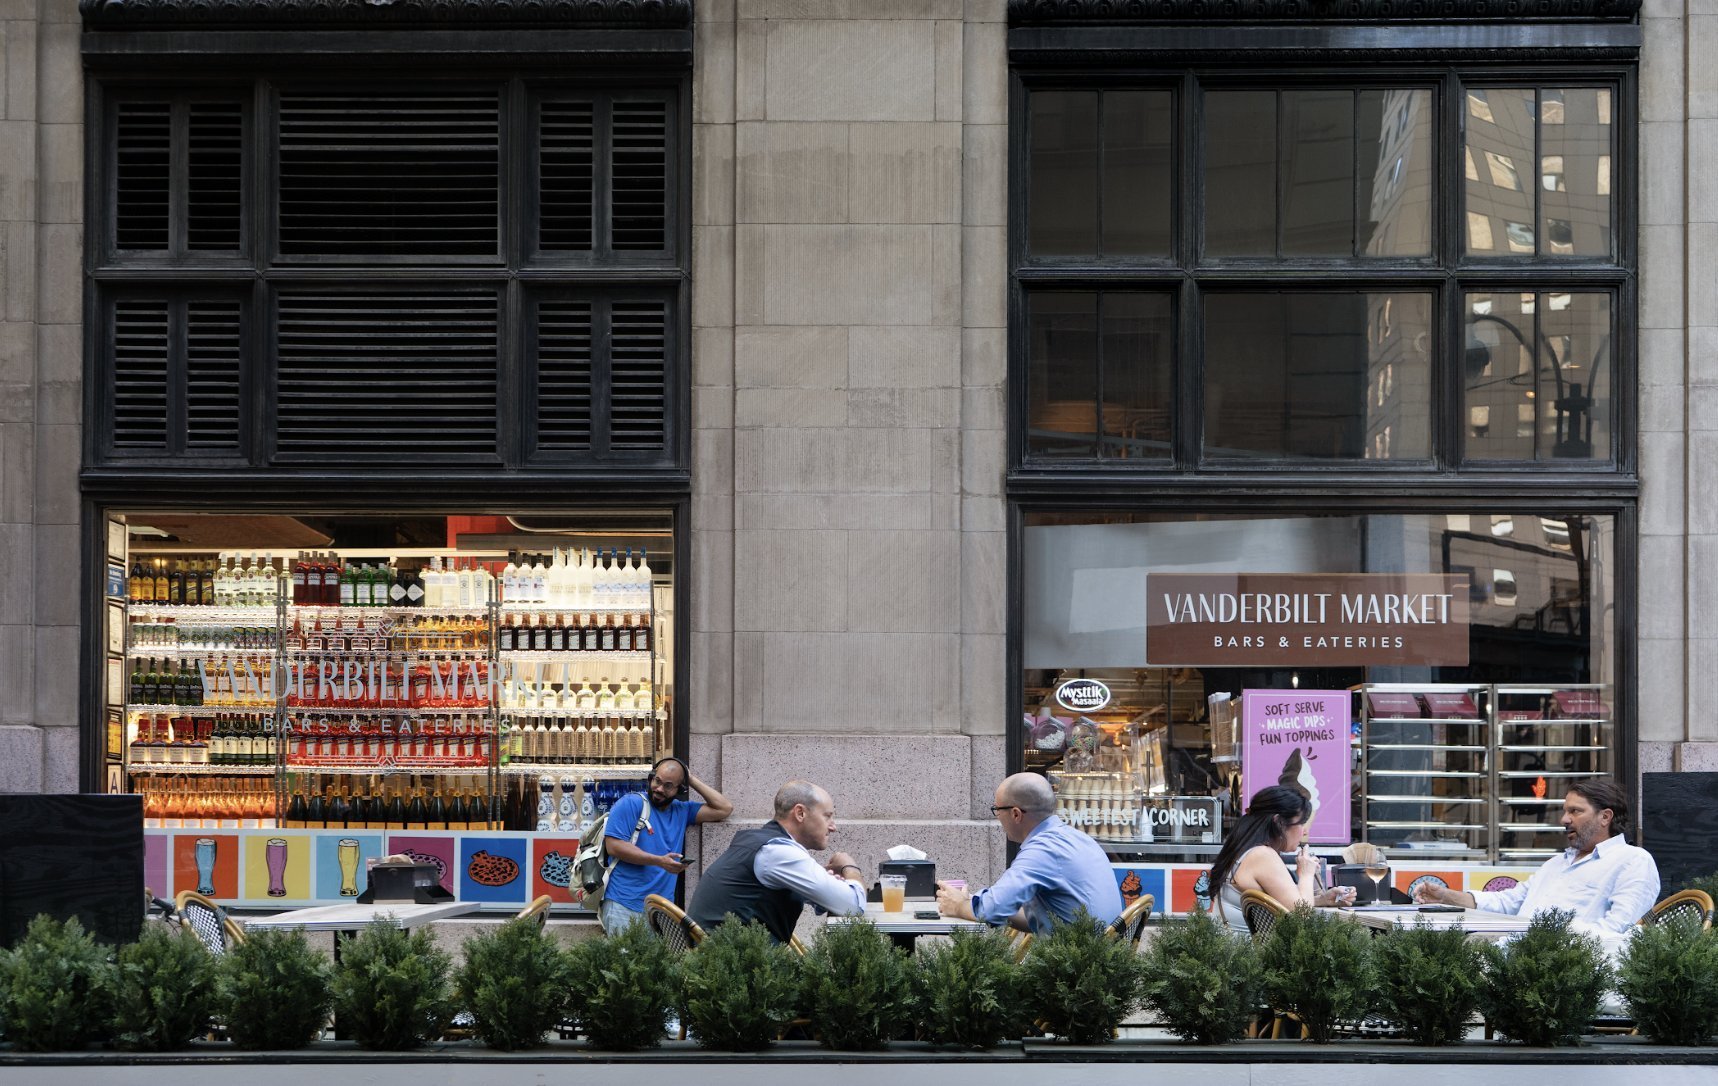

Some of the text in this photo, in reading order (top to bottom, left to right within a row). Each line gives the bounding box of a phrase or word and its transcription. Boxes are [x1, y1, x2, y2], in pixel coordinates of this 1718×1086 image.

[1164, 593, 1453, 624] VANDERBILT MARKET
[1214, 636, 1403, 648] BARS & EATERIES
[197, 659, 412, 701] VANDERBILT
[1265, 701, 1325, 716] SOFT SERVE
[263, 717, 512, 733] BARS & EATERIES
[1266, 715, 1326, 730] MAGIC DIPS
[1259, 729, 1335, 746] FUN TOPPINGS
[1060, 807, 1210, 828] SWEETEST CORNER
